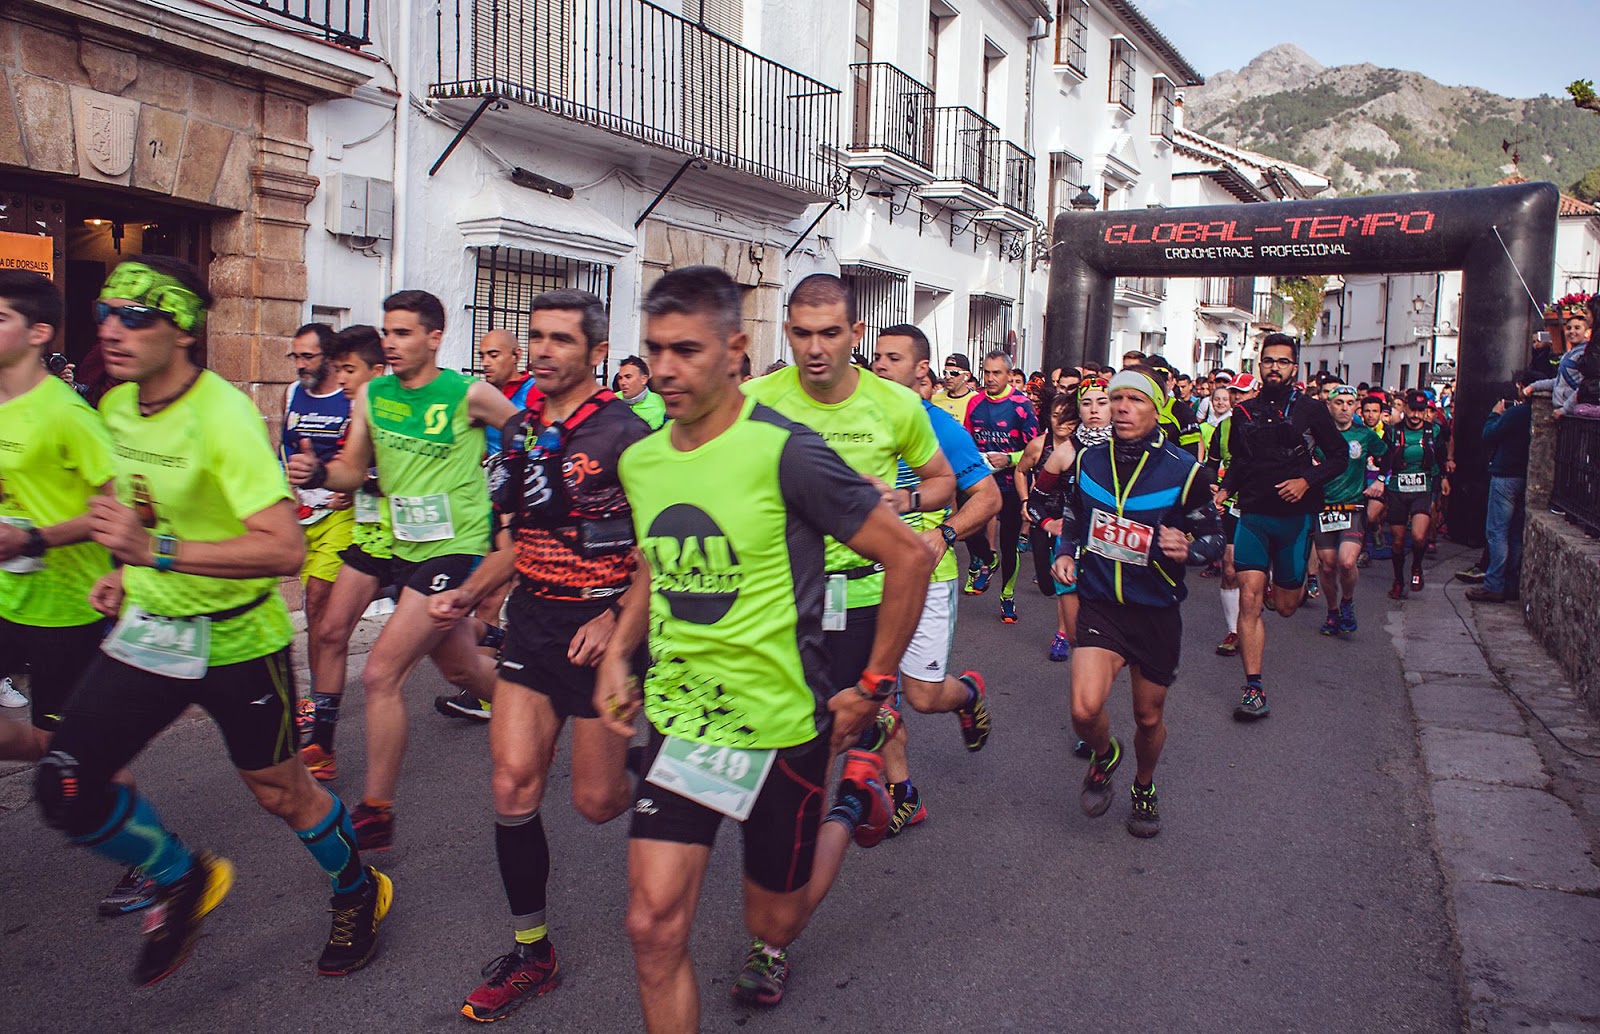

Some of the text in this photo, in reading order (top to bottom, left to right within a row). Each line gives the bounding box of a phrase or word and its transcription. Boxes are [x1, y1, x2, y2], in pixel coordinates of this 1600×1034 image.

[1165, 243, 1351, 259] CRONOMETRAJE PROFESIONAL
[5, 258, 15, 268] DE
[16, 260, 49, 271] DORSALES
[405, 505, 439, 524] 195
[1103, 524, 1141, 549] 510
